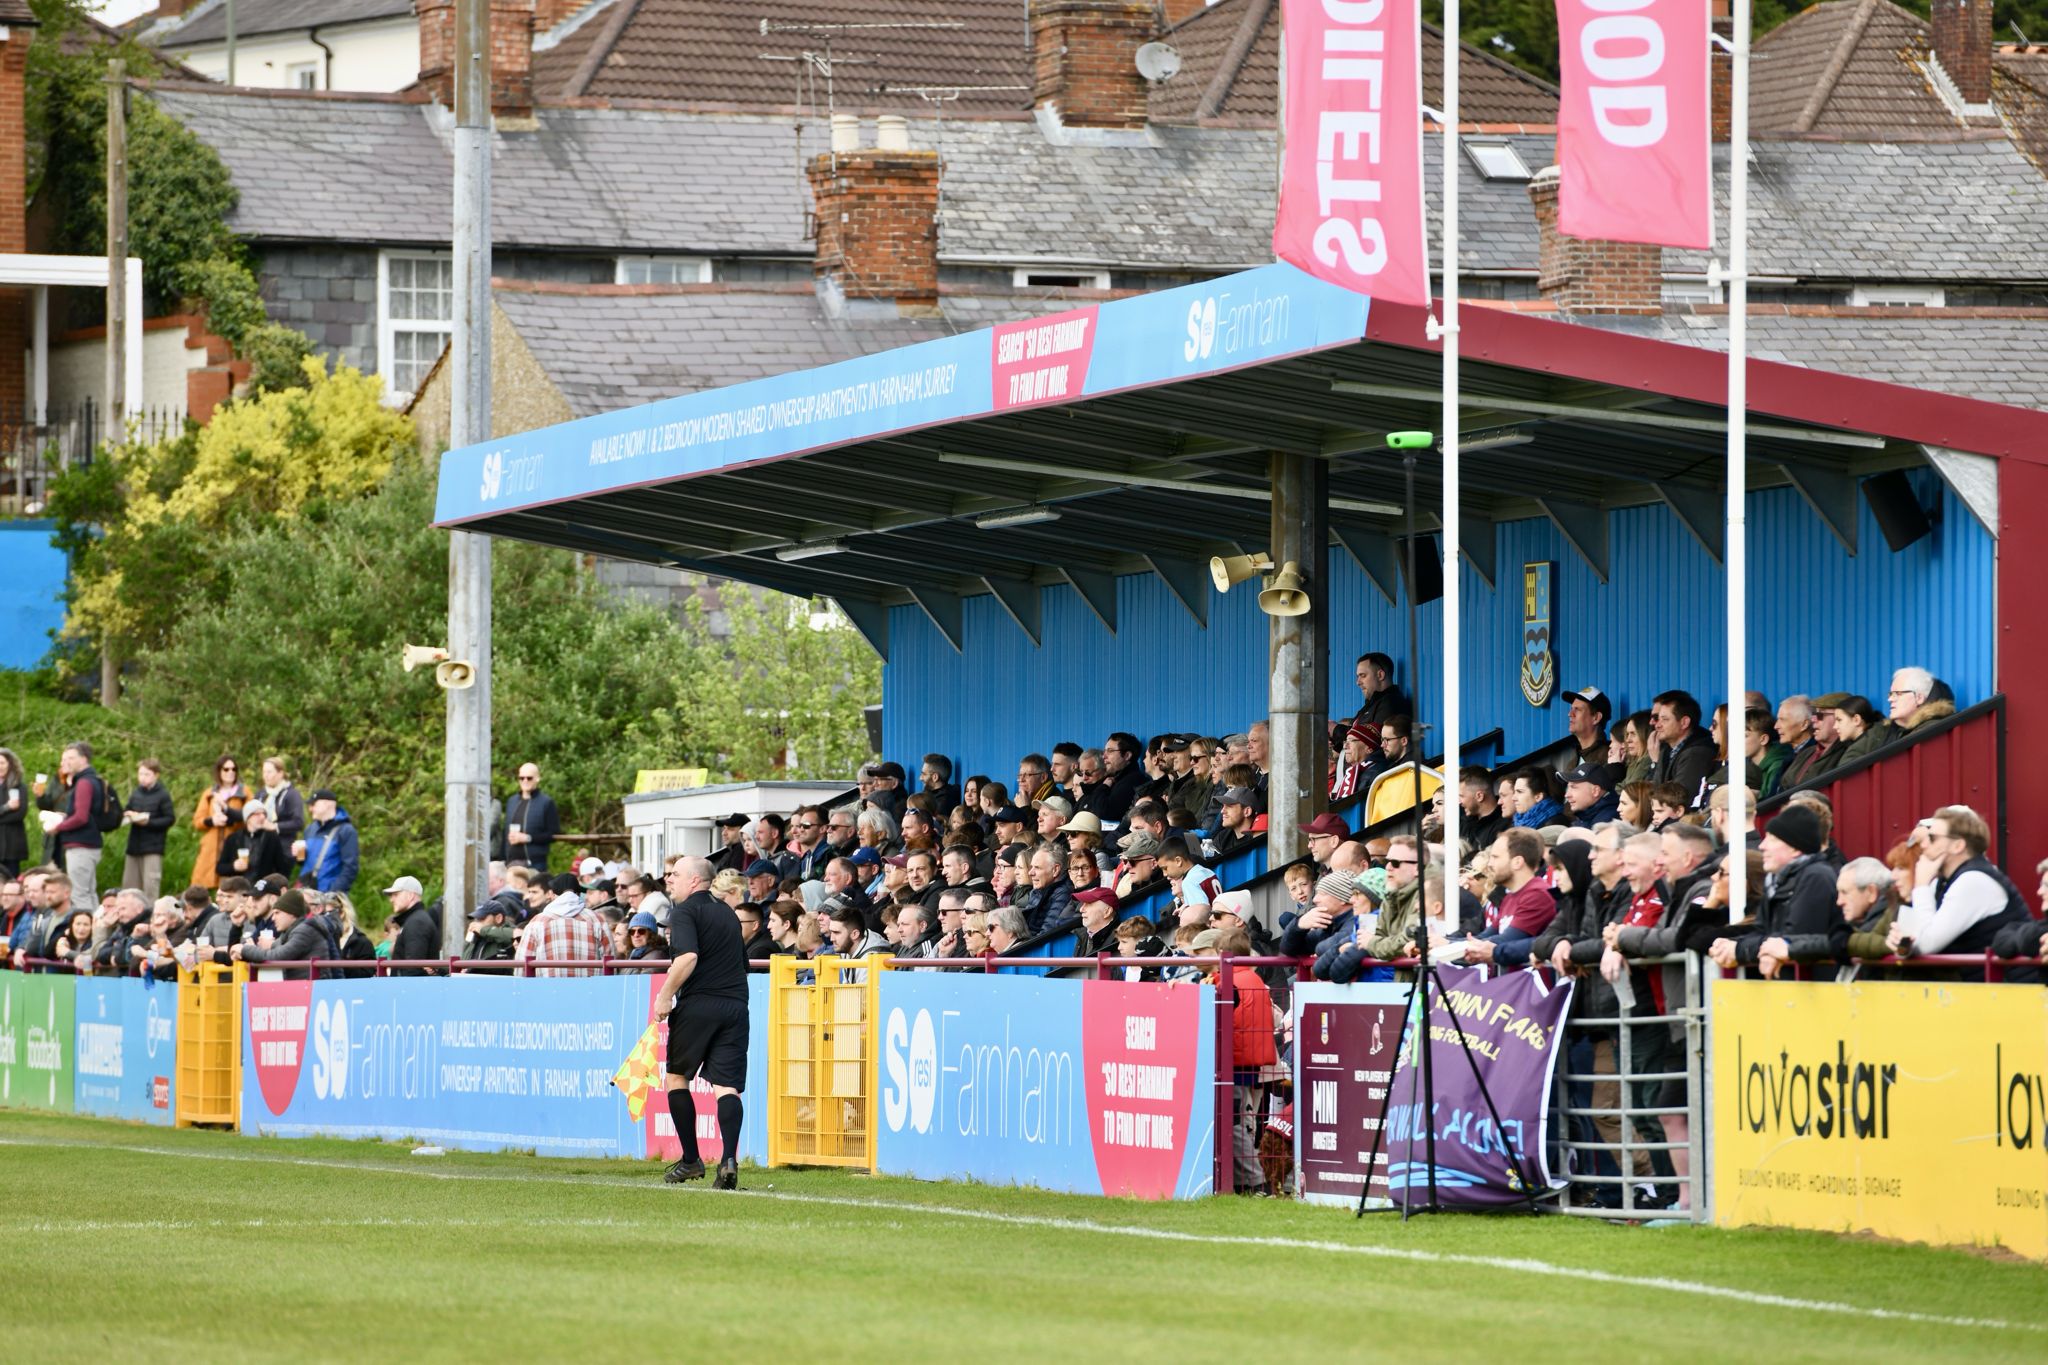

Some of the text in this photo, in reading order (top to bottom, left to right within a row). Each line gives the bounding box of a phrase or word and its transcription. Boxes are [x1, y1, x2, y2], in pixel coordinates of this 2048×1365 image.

[1215, 286, 1290, 355] Farnham
[998, 331, 1025, 365] SEARCH
[1036, 324, 1054, 357] RESI
[1009, 365, 1069, 405] TO FIND OUT MORE
[589, 433, 625, 465] AVAILABLE
[624, 428, 646, 459] NOW!
[657, 425, 665, 451] 2
[663, 418, 702, 451] BEDROOM
[701, 411, 736, 444] MODERN
[736, 404, 767, 436] SHARED
[768, 395, 816, 431] OWNERSHIP
[814, 383, 868, 422] APARTMENTS
[868, 381, 880, 410] IN
[880, 371, 923, 407] FARNHAM,
[923, 363, 958, 398] SURREY
[313, 998, 436, 1100] SO Farnham
[442, 1020, 476, 1048] AVAILABLE
[476, 1021, 498, 1048] NOW!
[504, 1022, 510, 1049] &
[515, 1022, 550, 1050] BEDROOM
[551, 1023, 584, 1051] MODERN
[584, 1022, 614, 1051] SHARED
[1125, 1015, 1156, 1051] SEARCH
[440, 1064, 614, 1101] OWNERSHIP APARTMENTS IN FARNHAM, SURREY
[884, 1007, 1073, 1147] SO Farnham
[914, 1049, 932, 1088] resi
[1118, 1063, 1136, 1098] RESI
[1738, 1034, 1897, 1140] lavastar
[1313, 1080, 1338, 1125] MINI
[1104, 1110, 1173, 1150] TO FIND OUT MORE
[1739, 1169, 1902, 1198] BUILDING WRAPS HOARDINGS SIGNAGE
[1997, 1187, 2041, 1210] BUILDING
